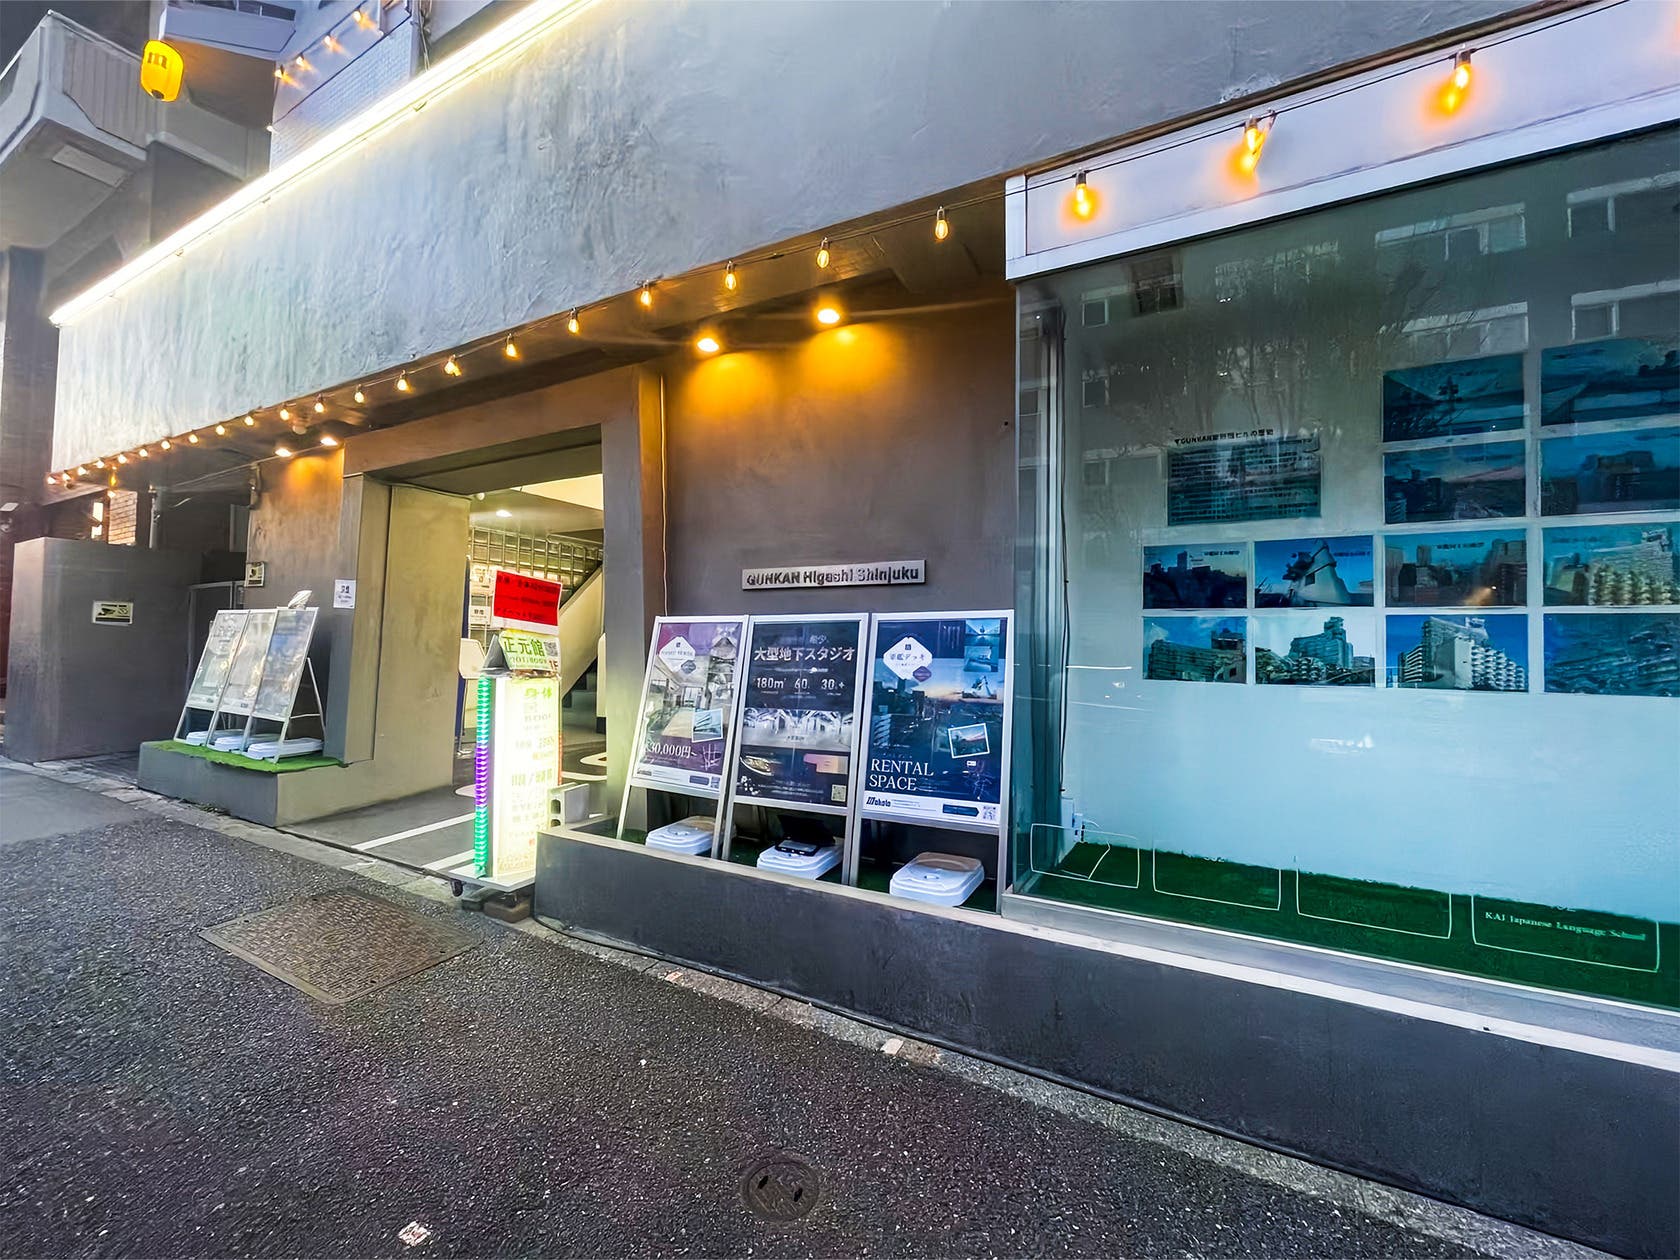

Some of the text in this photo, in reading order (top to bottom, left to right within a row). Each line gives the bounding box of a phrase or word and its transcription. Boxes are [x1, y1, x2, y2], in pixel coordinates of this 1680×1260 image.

[746, 566, 919, 586] GUNKAN Higashi Shinjuku
[754, 646, 856, 662] 大型地下スタジオ
[871, 758, 935, 777] RENTAL
[868, 773, 918, 792] SPACE
[1510, 915, 1553, 928] Japanese
[1556, 921, 1606, 937] Language
